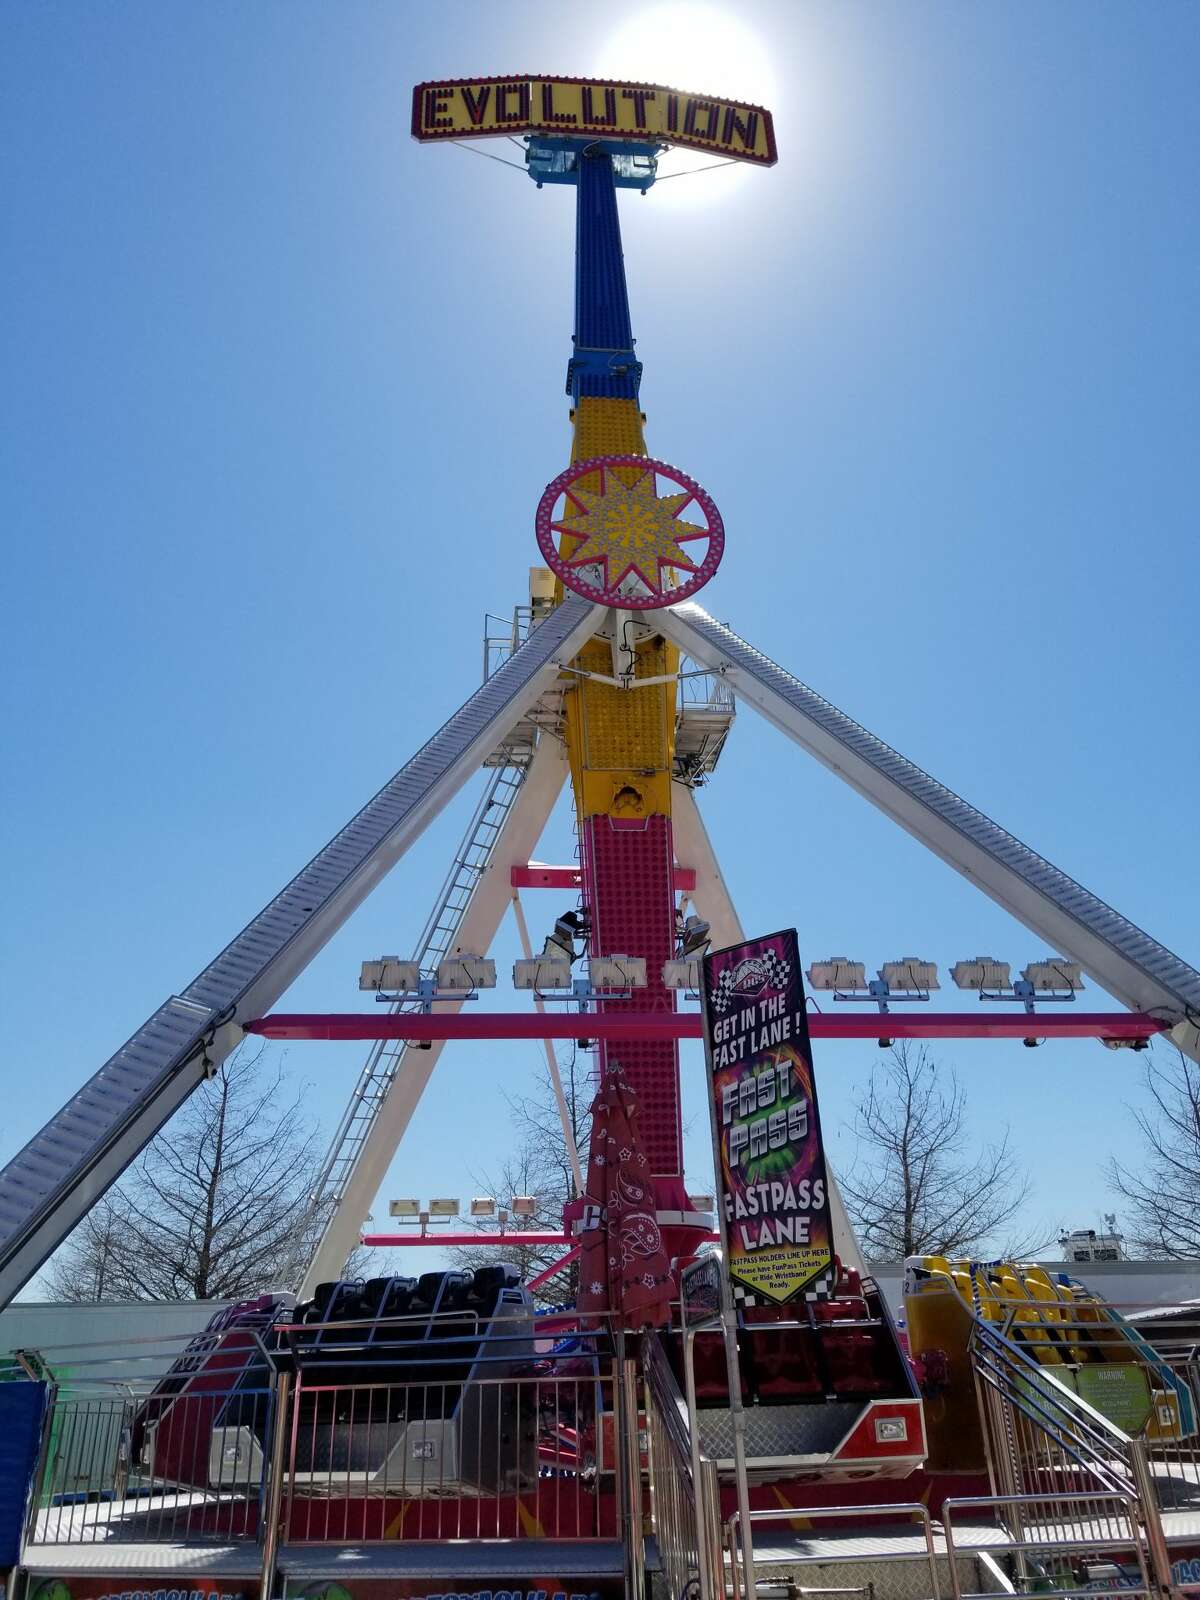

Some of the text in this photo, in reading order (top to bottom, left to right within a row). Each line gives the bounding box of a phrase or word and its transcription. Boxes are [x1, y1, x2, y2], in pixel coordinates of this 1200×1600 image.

[425, 83, 758, 149] EVOLUTION
[713, 993, 786, 1044] GET IN THE
[712, 1037, 746, 1071] FAST
[751, 1017, 791, 1055] LANE
[722, 1059, 793, 1125] FAST
[729, 1100, 808, 1168] PASS
[724, 1179, 825, 1222] FASTPASS
[740, 1216, 811, 1250] LANE
[730, 1256, 758, 1266] FASTPASS
[759, 1253, 785, 1263] HOLDERS
[802, 1250, 811, 1258] UP
[812, 1248, 829, 1256] HERE
[772, 1263, 797, 1271] FunPass
[799, 1260, 822, 1268] Tickets
[775, 1270, 807, 1279] Wristband
